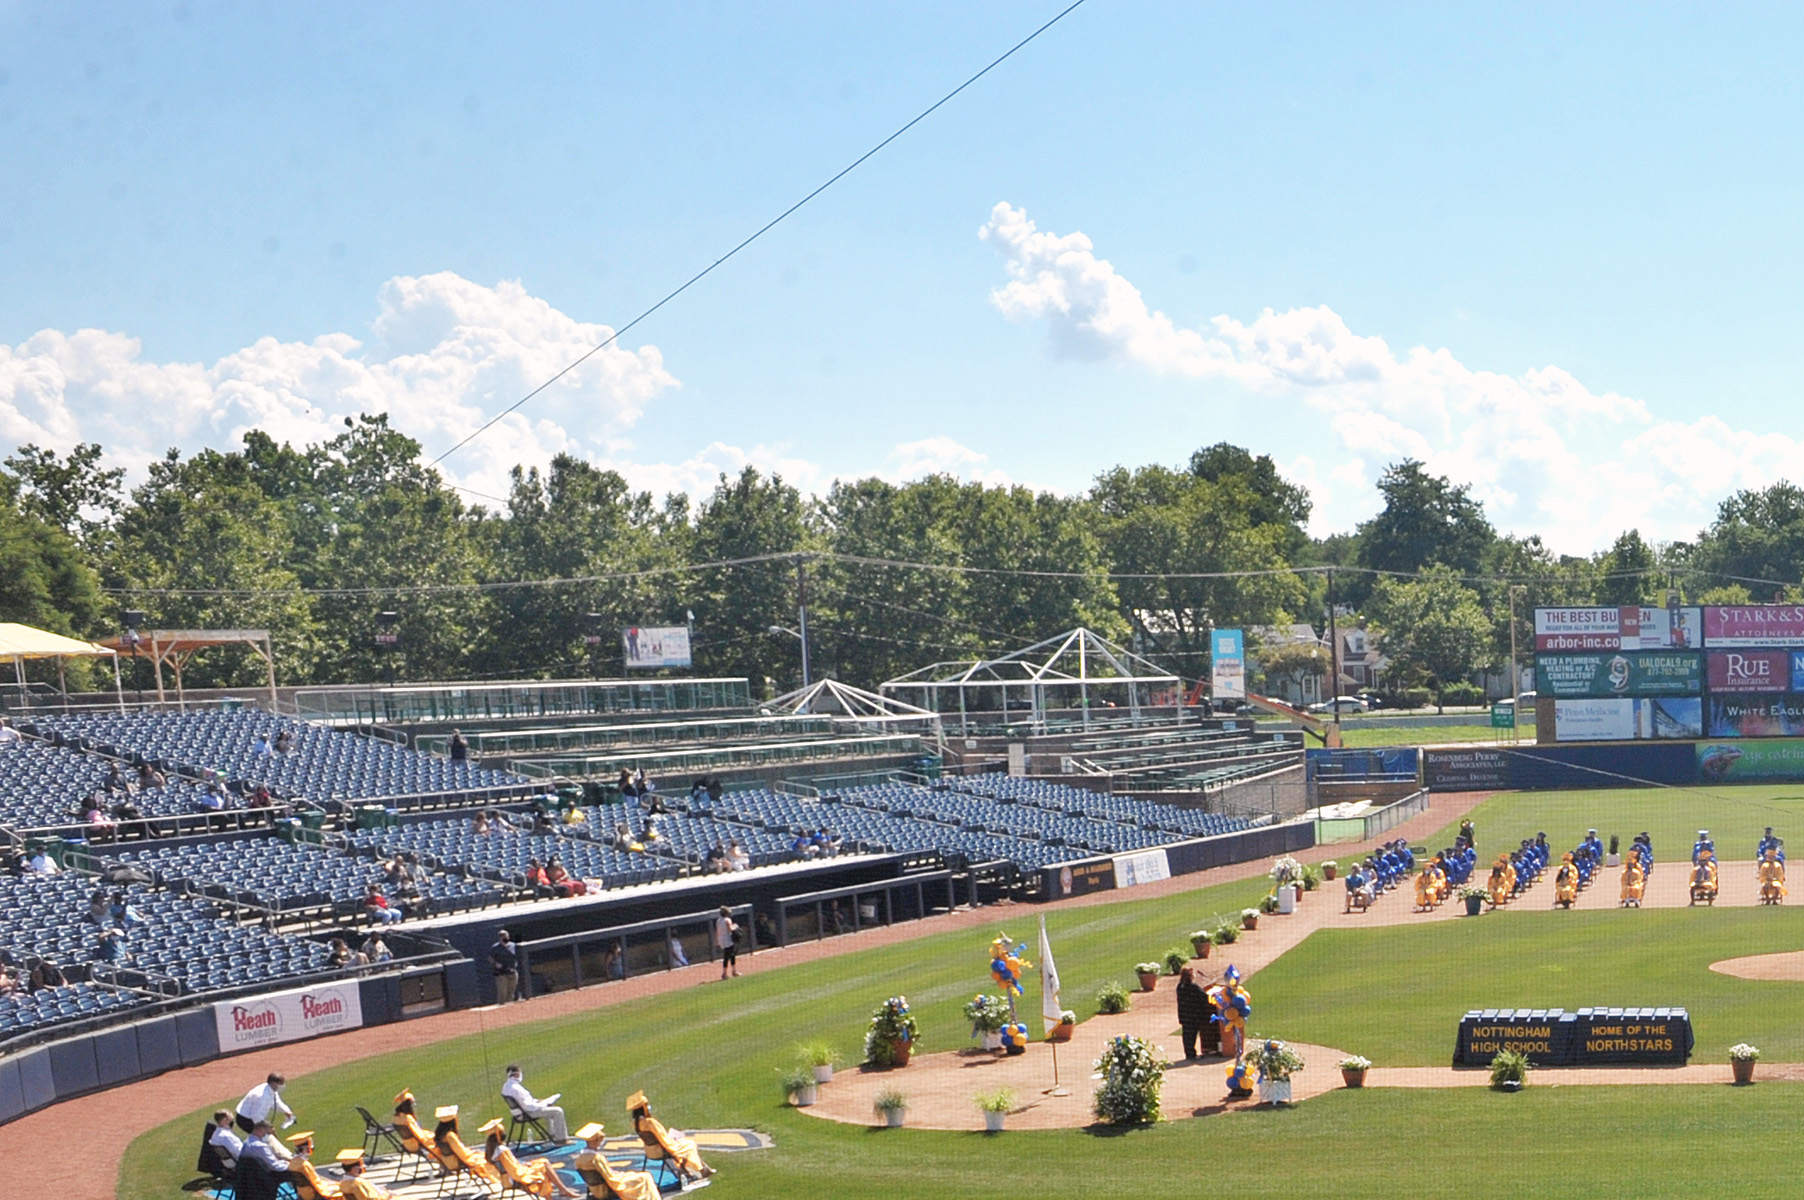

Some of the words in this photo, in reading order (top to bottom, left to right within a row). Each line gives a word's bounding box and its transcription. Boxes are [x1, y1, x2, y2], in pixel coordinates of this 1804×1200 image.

[1545, 612, 1567, 623] THE
[1570, 612, 1598, 623] BEST
[1734, 629, 1795, 637] ATTORNEYS
[1547, 636, 1620, 648] arbor-inc.co
[1726, 654, 1770, 678] RUE
[1727, 675, 1770, 686] Insurance
[301, 995, 342, 1019] Heath
[232, 1006, 276, 1032] Heath
[304, 1014, 343, 1030] LUMBER
[235, 1027, 278, 1042] LUMBER
[1472, 1026, 1551, 1038] NOTTINGHAM
[1592, 1026, 1623, 1036] HOME
[1628, 1025, 1641, 1035] OF
[1645, 1025, 1666, 1035] THE
[1471, 1041, 1499, 1052] HIGH
[1503, 1041, 1551, 1053] SCHOOL
[1586, 1038, 1673, 1051] NORTHSTARS
